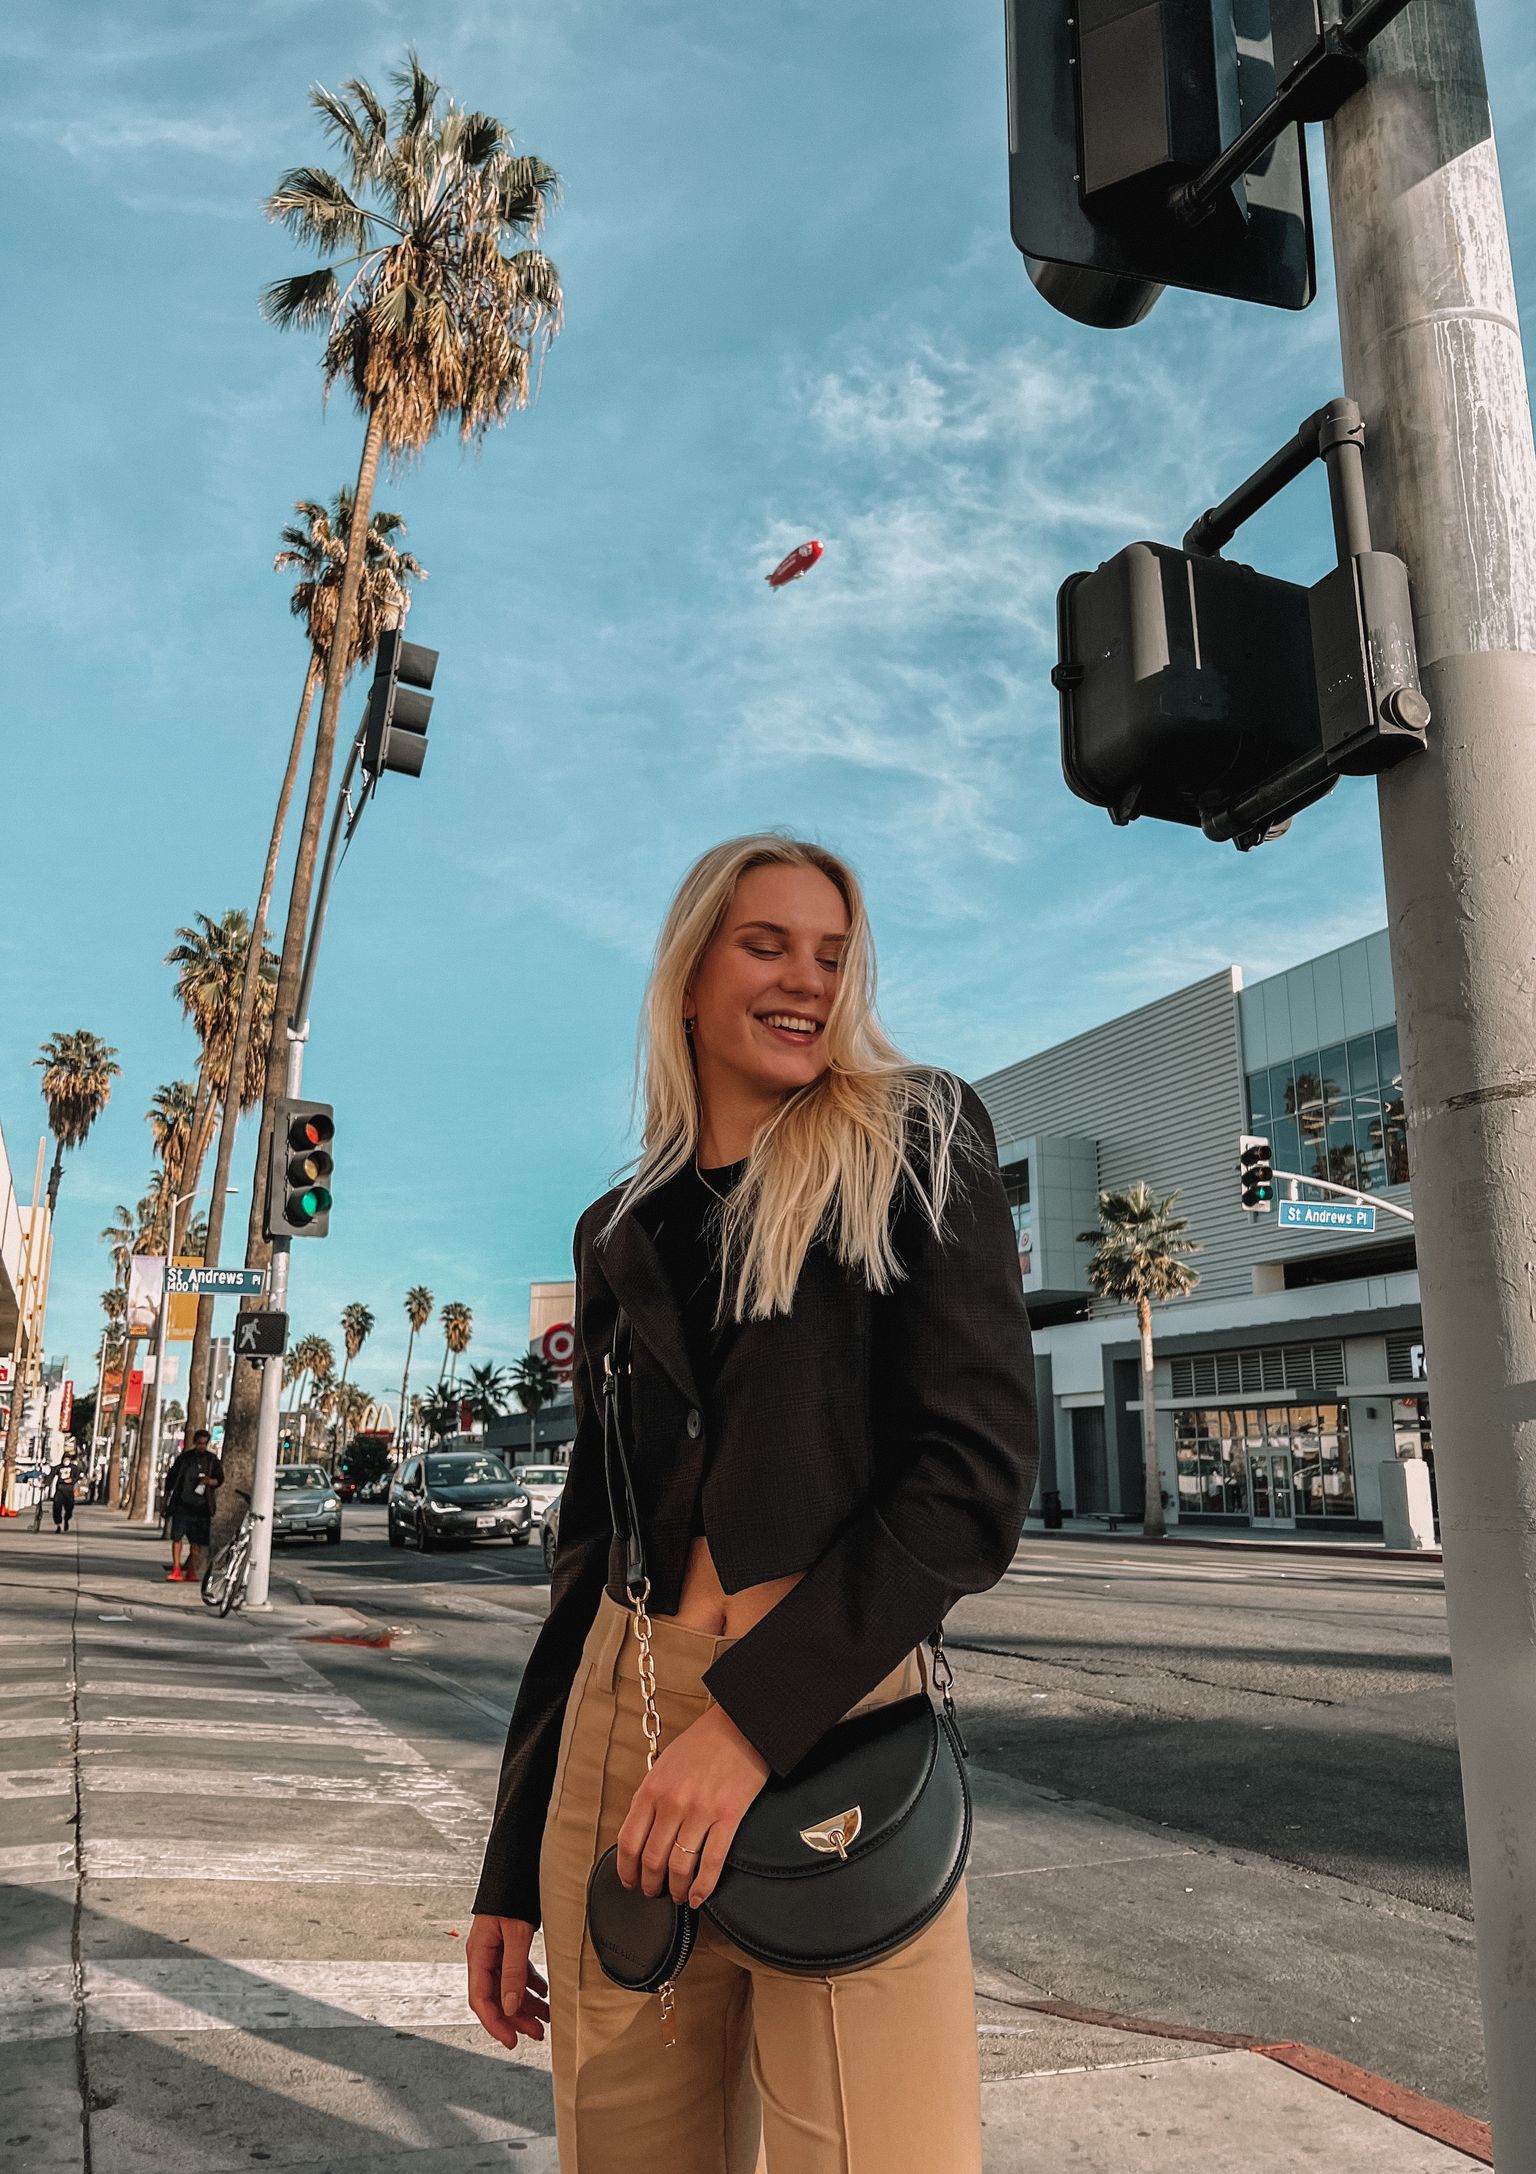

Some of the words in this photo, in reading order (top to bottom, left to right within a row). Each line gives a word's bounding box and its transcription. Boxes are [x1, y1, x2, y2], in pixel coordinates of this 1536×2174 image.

[1287, 1206, 1301, 1222] St
[1304, 1208, 1352, 1225] Andrews
[1356, 1211, 1367, 1225] Pl
[167, 1267, 183, 1282] St
[188, 1268, 244, 1285] Andrews
[252, 1275, 261, 1285] Pl
[167, 1281, 189, 1292] 1400
[191, 1282, 200, 1292] N
